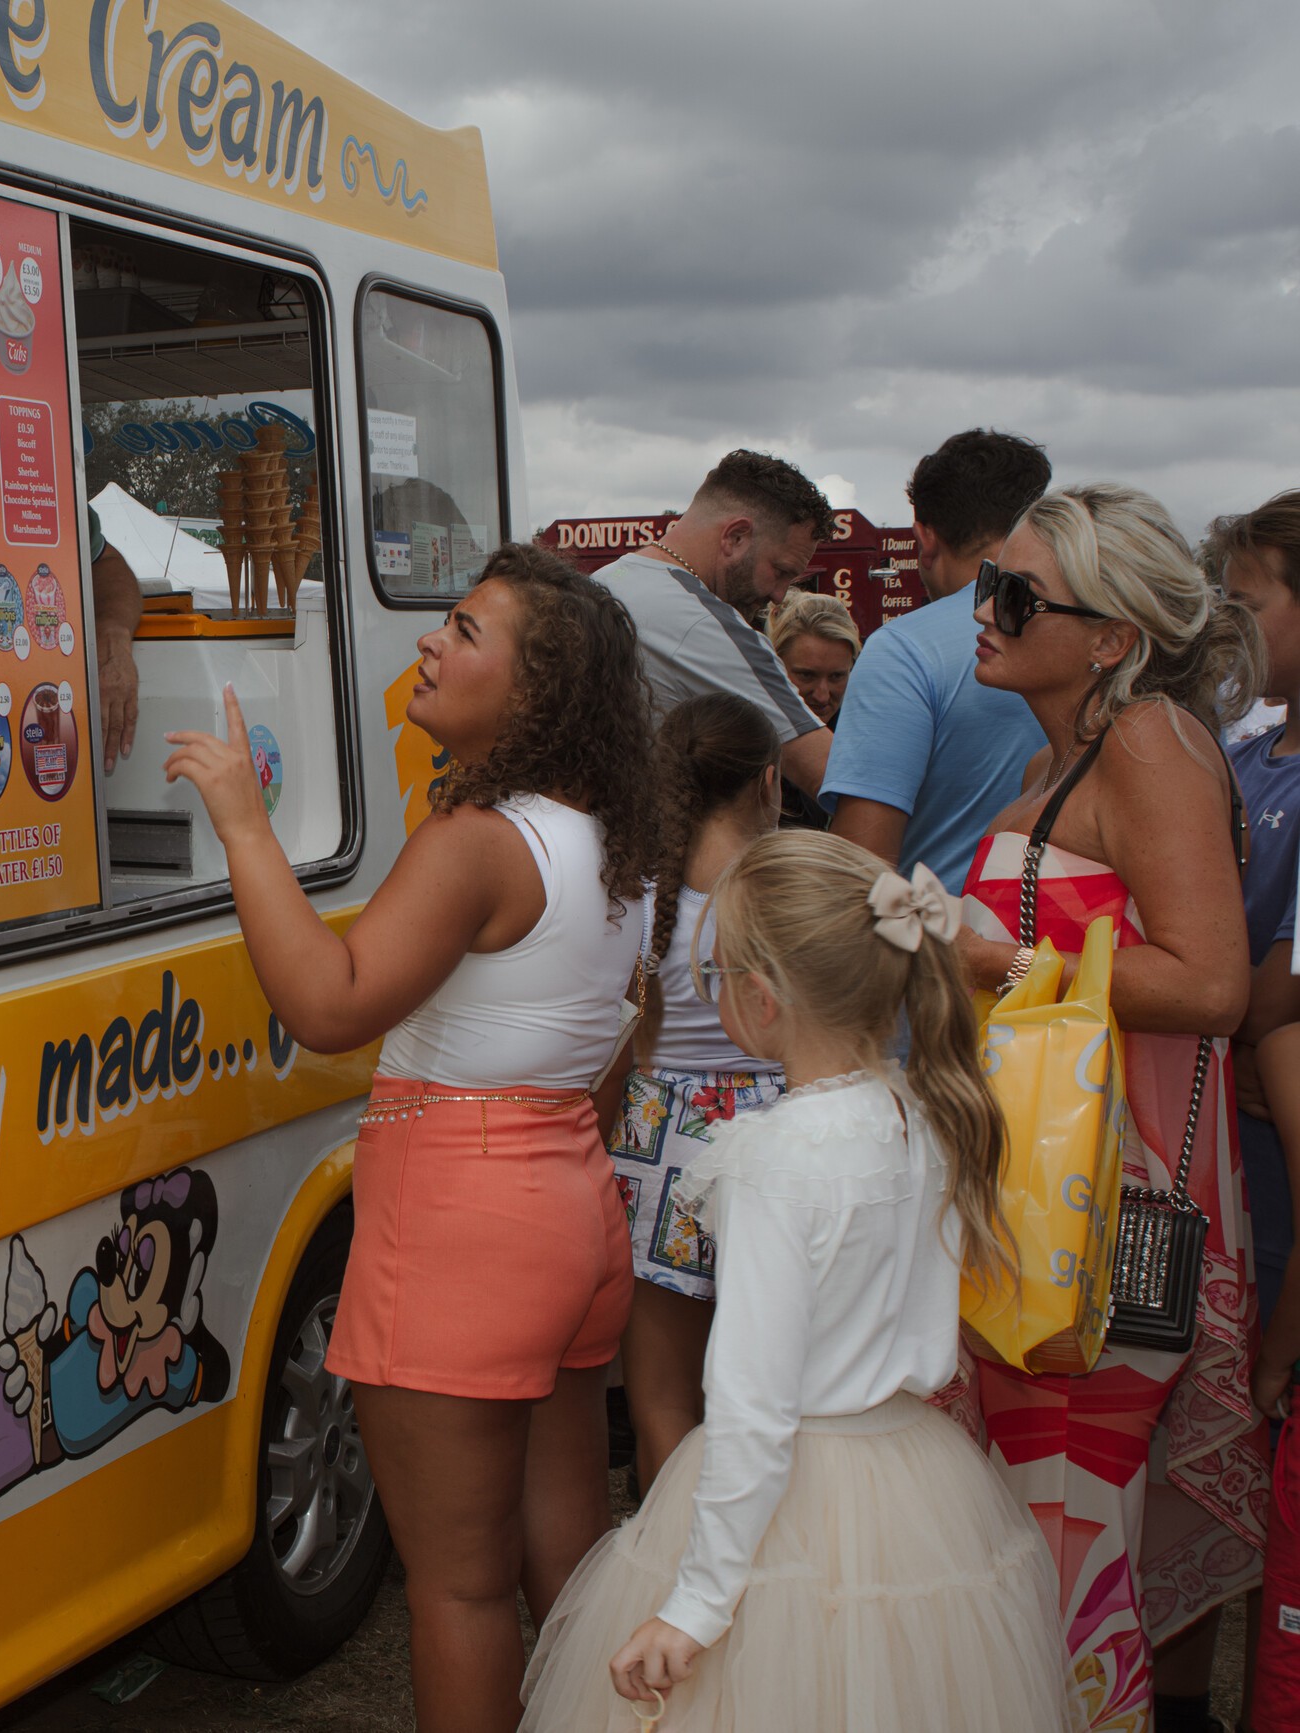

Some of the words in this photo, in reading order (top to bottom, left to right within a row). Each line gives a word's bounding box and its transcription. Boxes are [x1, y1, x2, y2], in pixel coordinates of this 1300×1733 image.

[89, 0, 327, 200] Cream
[18, 242, 42, 256] MEDIUM
[22, 262, 40, 276] £3.00
[23, 283, 40, 297] £3.50
[7, 341, 27, 362] Tubs
[8, 405, 41, 420] TOPPINGS
[17, 422, 35, 434] £0.50
[17, 438, 37, 449] Biscoff
[20, 453, 36, 463] Oreo
[17, 467, 40, 478] Sherbet
[4, 480, 29, 491] Rainbow
[29, 482, 54, 495] Sprinkles
[4, 494, 32, 505] Chocolate
[32, 496, 57, 508] Sprinkles
[13, 524, 52, 537] Marshmallows
[881, 538, 887, 551] 1
[883, 577, 903, 589] TEA
[882, 594, 913, 608] COFFEE
[15, 637, 28, 647] £2.00
[60, 633, 72, 642] £2.00
[60, 693, 71, 702] £2.50
[25, 727, 43, 738] stella
[42, 824, 61, 847] OF
[32, 855, 63, 879] £1.50
